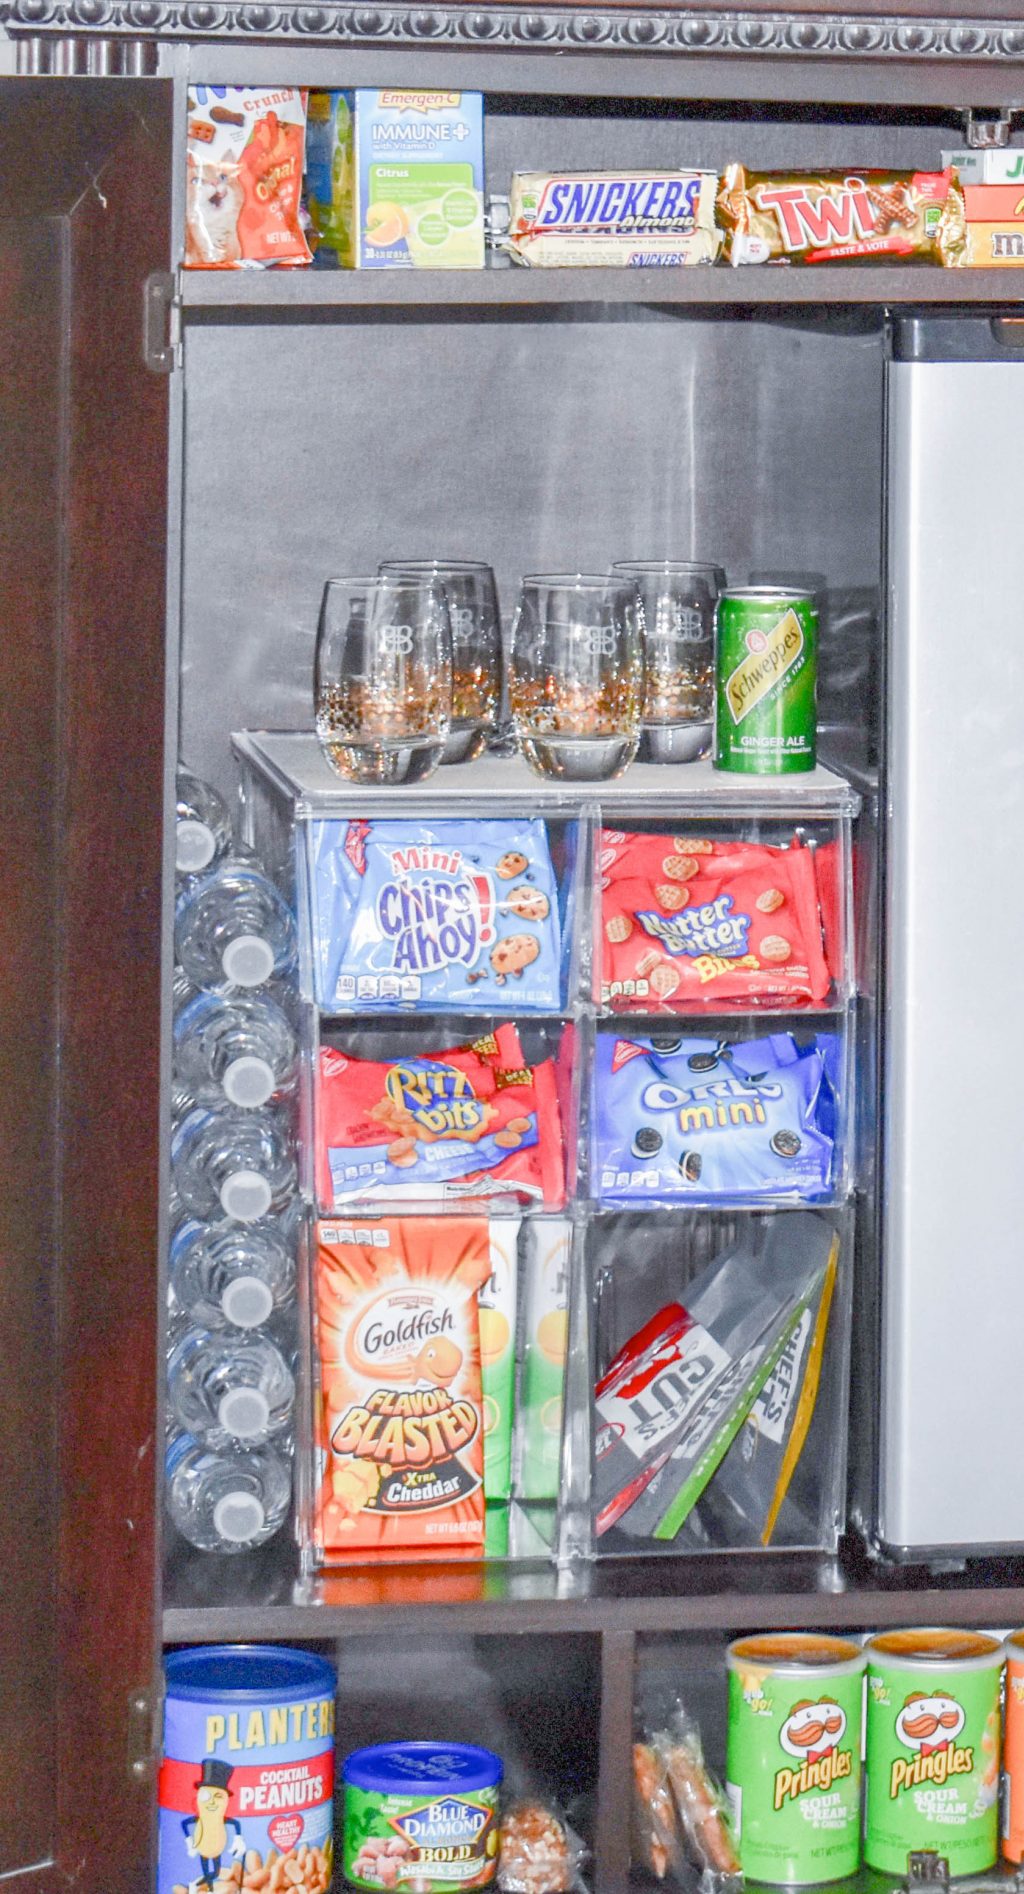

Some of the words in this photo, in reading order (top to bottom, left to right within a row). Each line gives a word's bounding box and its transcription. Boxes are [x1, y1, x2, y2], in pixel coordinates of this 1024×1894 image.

[376, 168, 409, 178] Citrus
[543, 180, 701, 224] SNICKERS
[730, 626, 800, 711] Schweppes
[741, 736, 785, 747] GINGER
[787, 736, 805, 746] ALE
[391, 847, 462, 876] Mini
[393, 1069, 468, 1110] RITZ
[417, 1101, 480, 1132] bits
[679, 1097, 767, 1133] mini
[364, 1308, 453, 1355] Goldfish
[367, 1388, 452, 1417] FLAVOR
[629, 1355, 716, 1430] CUT
[333, 1401, 478, 1465] BLASTED
[386, 1476, 461, 1503] Cheddar
[404, 1472, 437, 1487] XTRA
[260, 1766, 310, 1785] COCKTAIL
[774, 1744, 852, 1811] Pringles
[889, 1743, 974, 1800] Pringles
[240, 1775, 323, 1811] PEANUTS
[800, 1792, 841, 1810] SOUR
[914, 1788, 959, 1804] SOUR
[429, 1804, 469, 1822] BLUE
[803, 1806, 847, 1821] CREAM
[916, 1801, 968, 1815] CREAM
[405, 1813, 485, 1837] DIAMOND
[420, 1845, 471, 1862] BOLD
